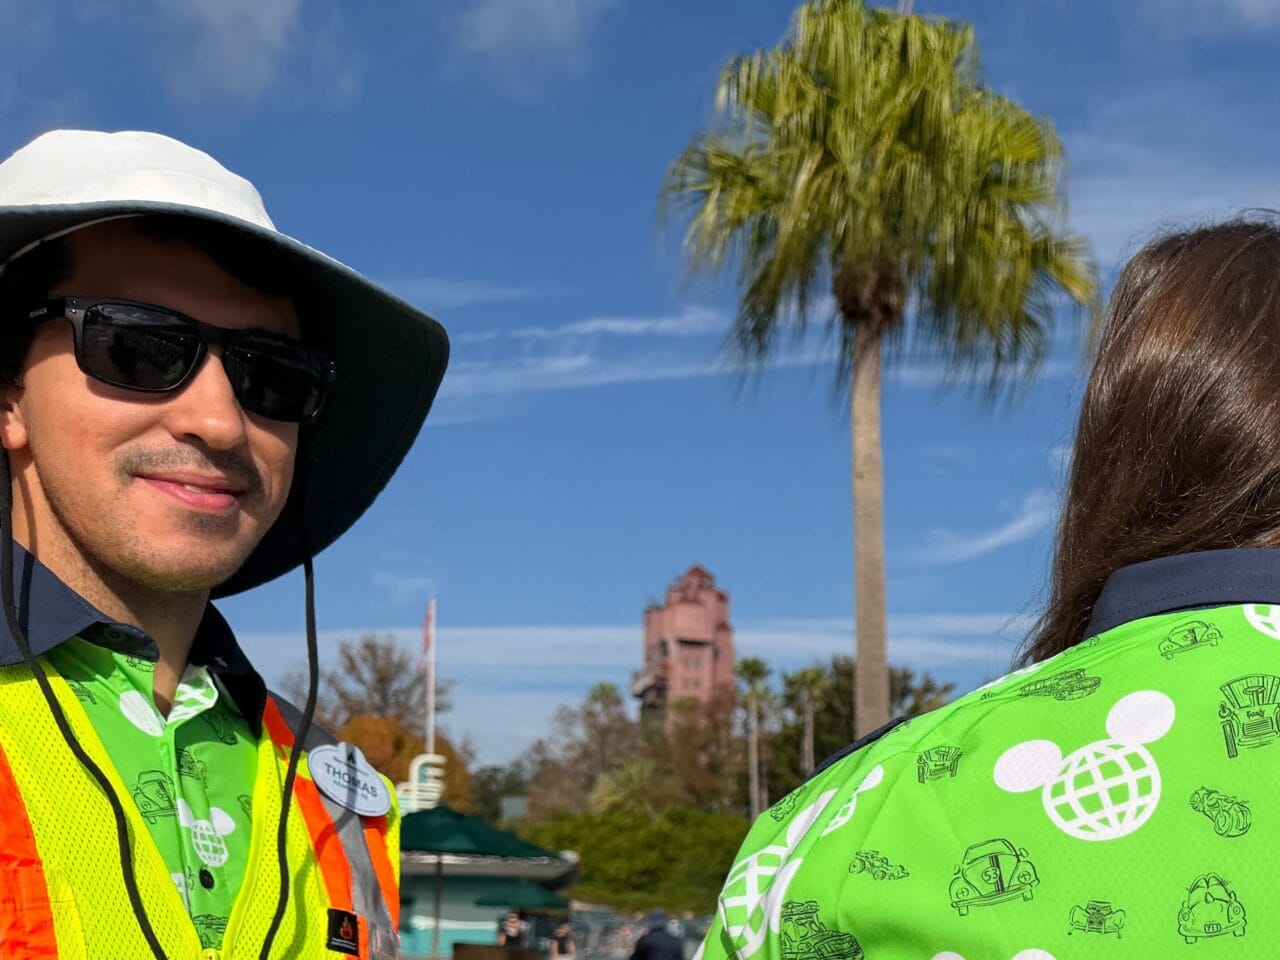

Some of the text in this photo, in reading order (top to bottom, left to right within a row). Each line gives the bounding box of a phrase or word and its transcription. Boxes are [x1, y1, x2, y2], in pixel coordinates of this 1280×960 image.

[324, 762, 378, 797] THOMAS
[157, 788, 169, 800] 53
[983, 868, 999, 882] 53
